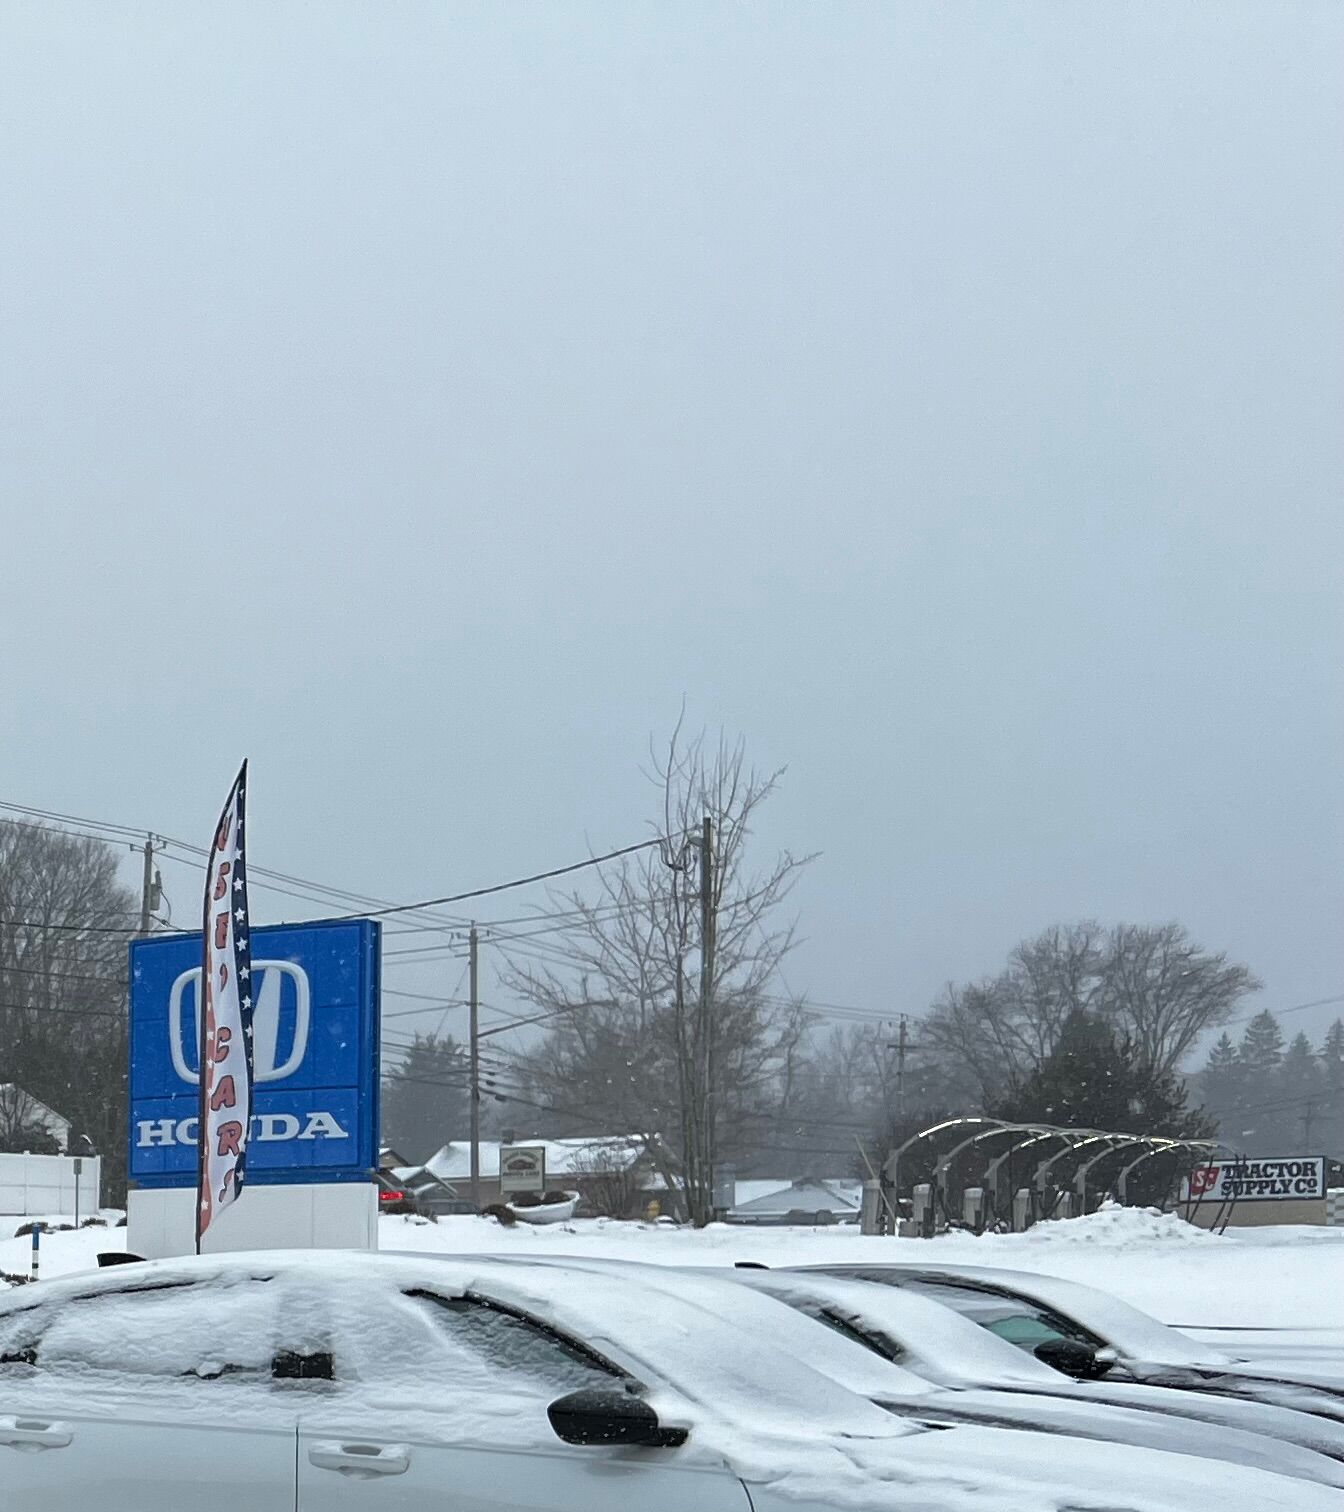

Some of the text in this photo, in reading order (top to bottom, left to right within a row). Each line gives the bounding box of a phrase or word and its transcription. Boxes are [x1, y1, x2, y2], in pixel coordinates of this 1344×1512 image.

[136, 1111, 349, 1147] HODA
[1221, 1161, 1318, 1179] TRACTOR
[1221, 1179, 1293, 1196] SUPPLY
